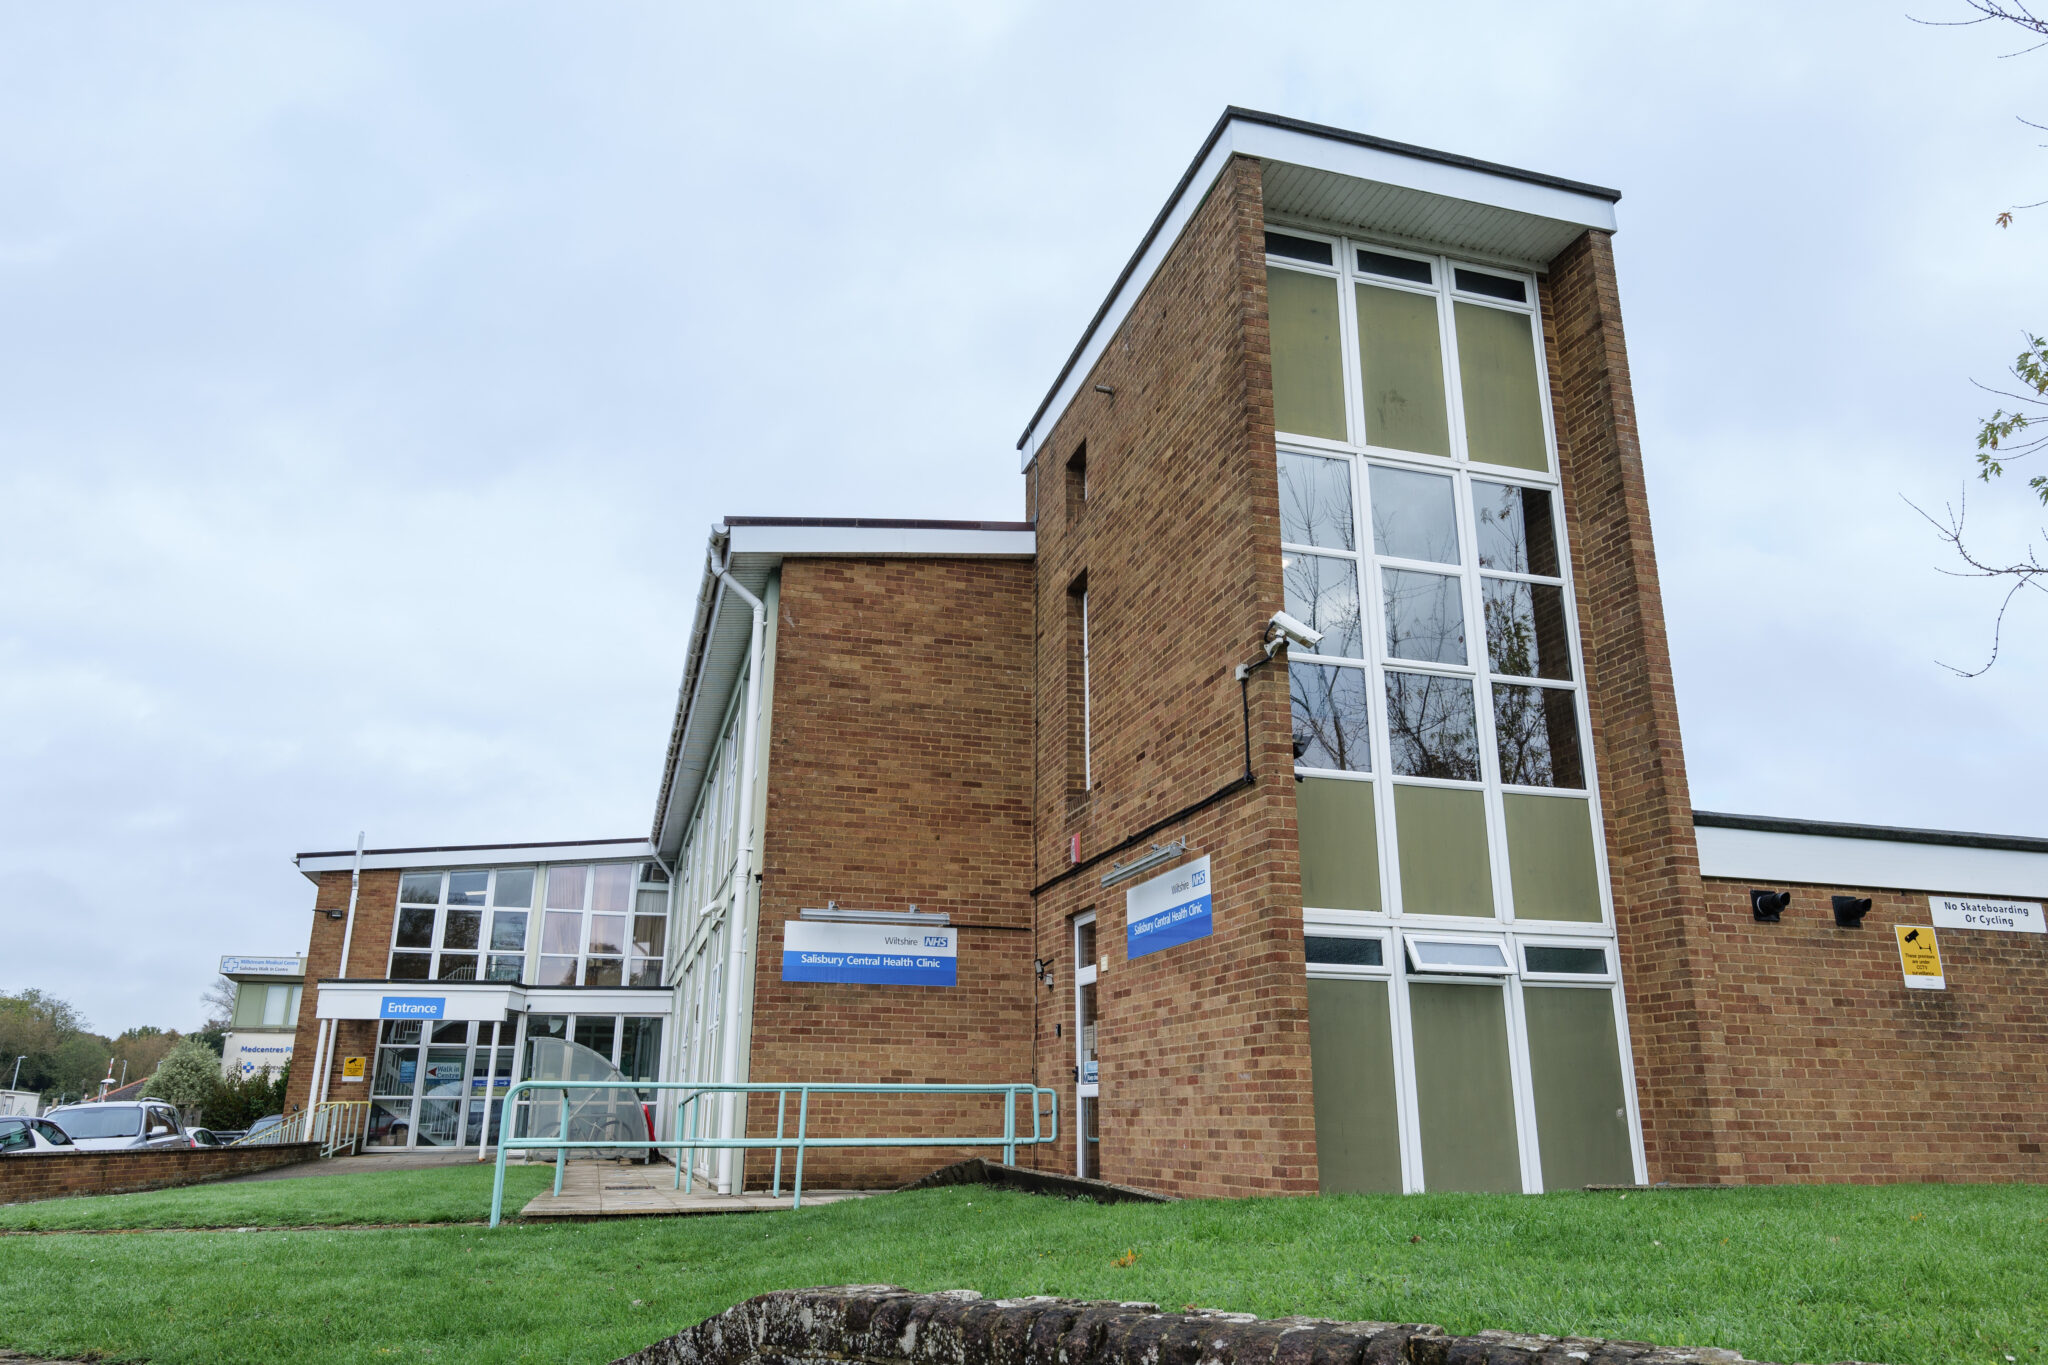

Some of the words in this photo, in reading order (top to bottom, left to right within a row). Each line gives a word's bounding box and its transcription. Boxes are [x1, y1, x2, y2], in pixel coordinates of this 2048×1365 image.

[1171, 881, 1189, 894] Wiltshire
[1192, 870, 1205, 887] NHS
[1944, 902, 1957, 910] No
[1961, 902, 2029, 916] Skateboarding
[1134, 922, 1154, 936] Salisbury
[1154, 912, 1170, 928] Central
[1171, 906, 1187, 922] Health
[1188, 902, 1202, 916] Clinic
[1965, 914, 1976, 923] Or
[1980, 915, 2014, 927] Cycling
[884, 936, 918, 946] Wiltshire
[925, 937, 947, 947] NHS
[801, 954, 843, 967] Salisbury
[846, 955, 880, 966] Central
[883, 957, 913, 967] Health
[916, 958, 941, 968] Clinic
[388, 1002, 438, 1014] Entrance
[240, 1045, 284, 1053] Medcentres
[437, 1065, 453, 1073] Walk
[453, 1065, 460, 1073] in
